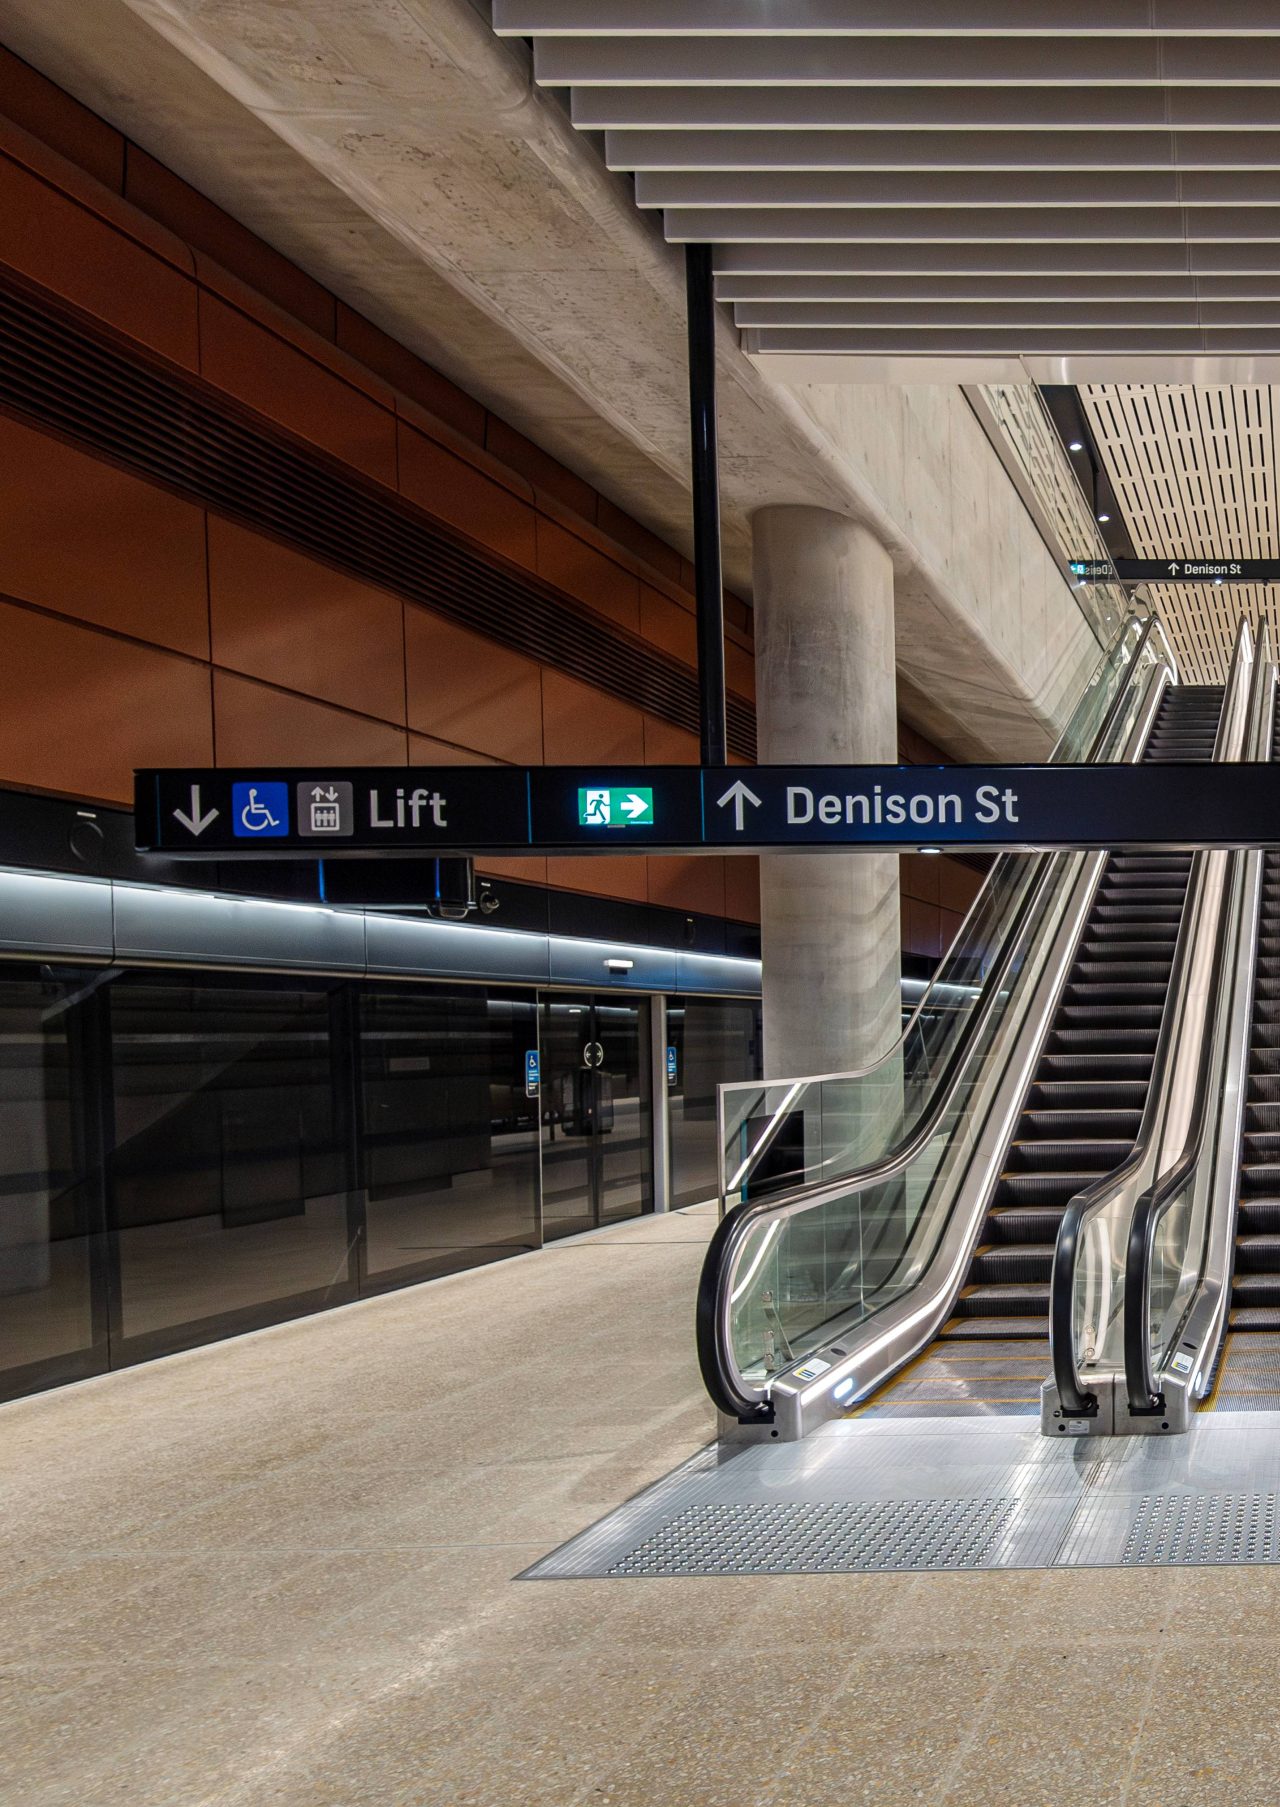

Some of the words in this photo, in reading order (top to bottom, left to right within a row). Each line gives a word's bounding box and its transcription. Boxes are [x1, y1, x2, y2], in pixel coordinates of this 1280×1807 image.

[1185, 563, 1227, 575] Denison
[1229, 563, 1241, 575] St
[369, 788, 448, 829] Lift
[785, 784, 963, 825] Denison
[973, 784, 1019, 825] St
